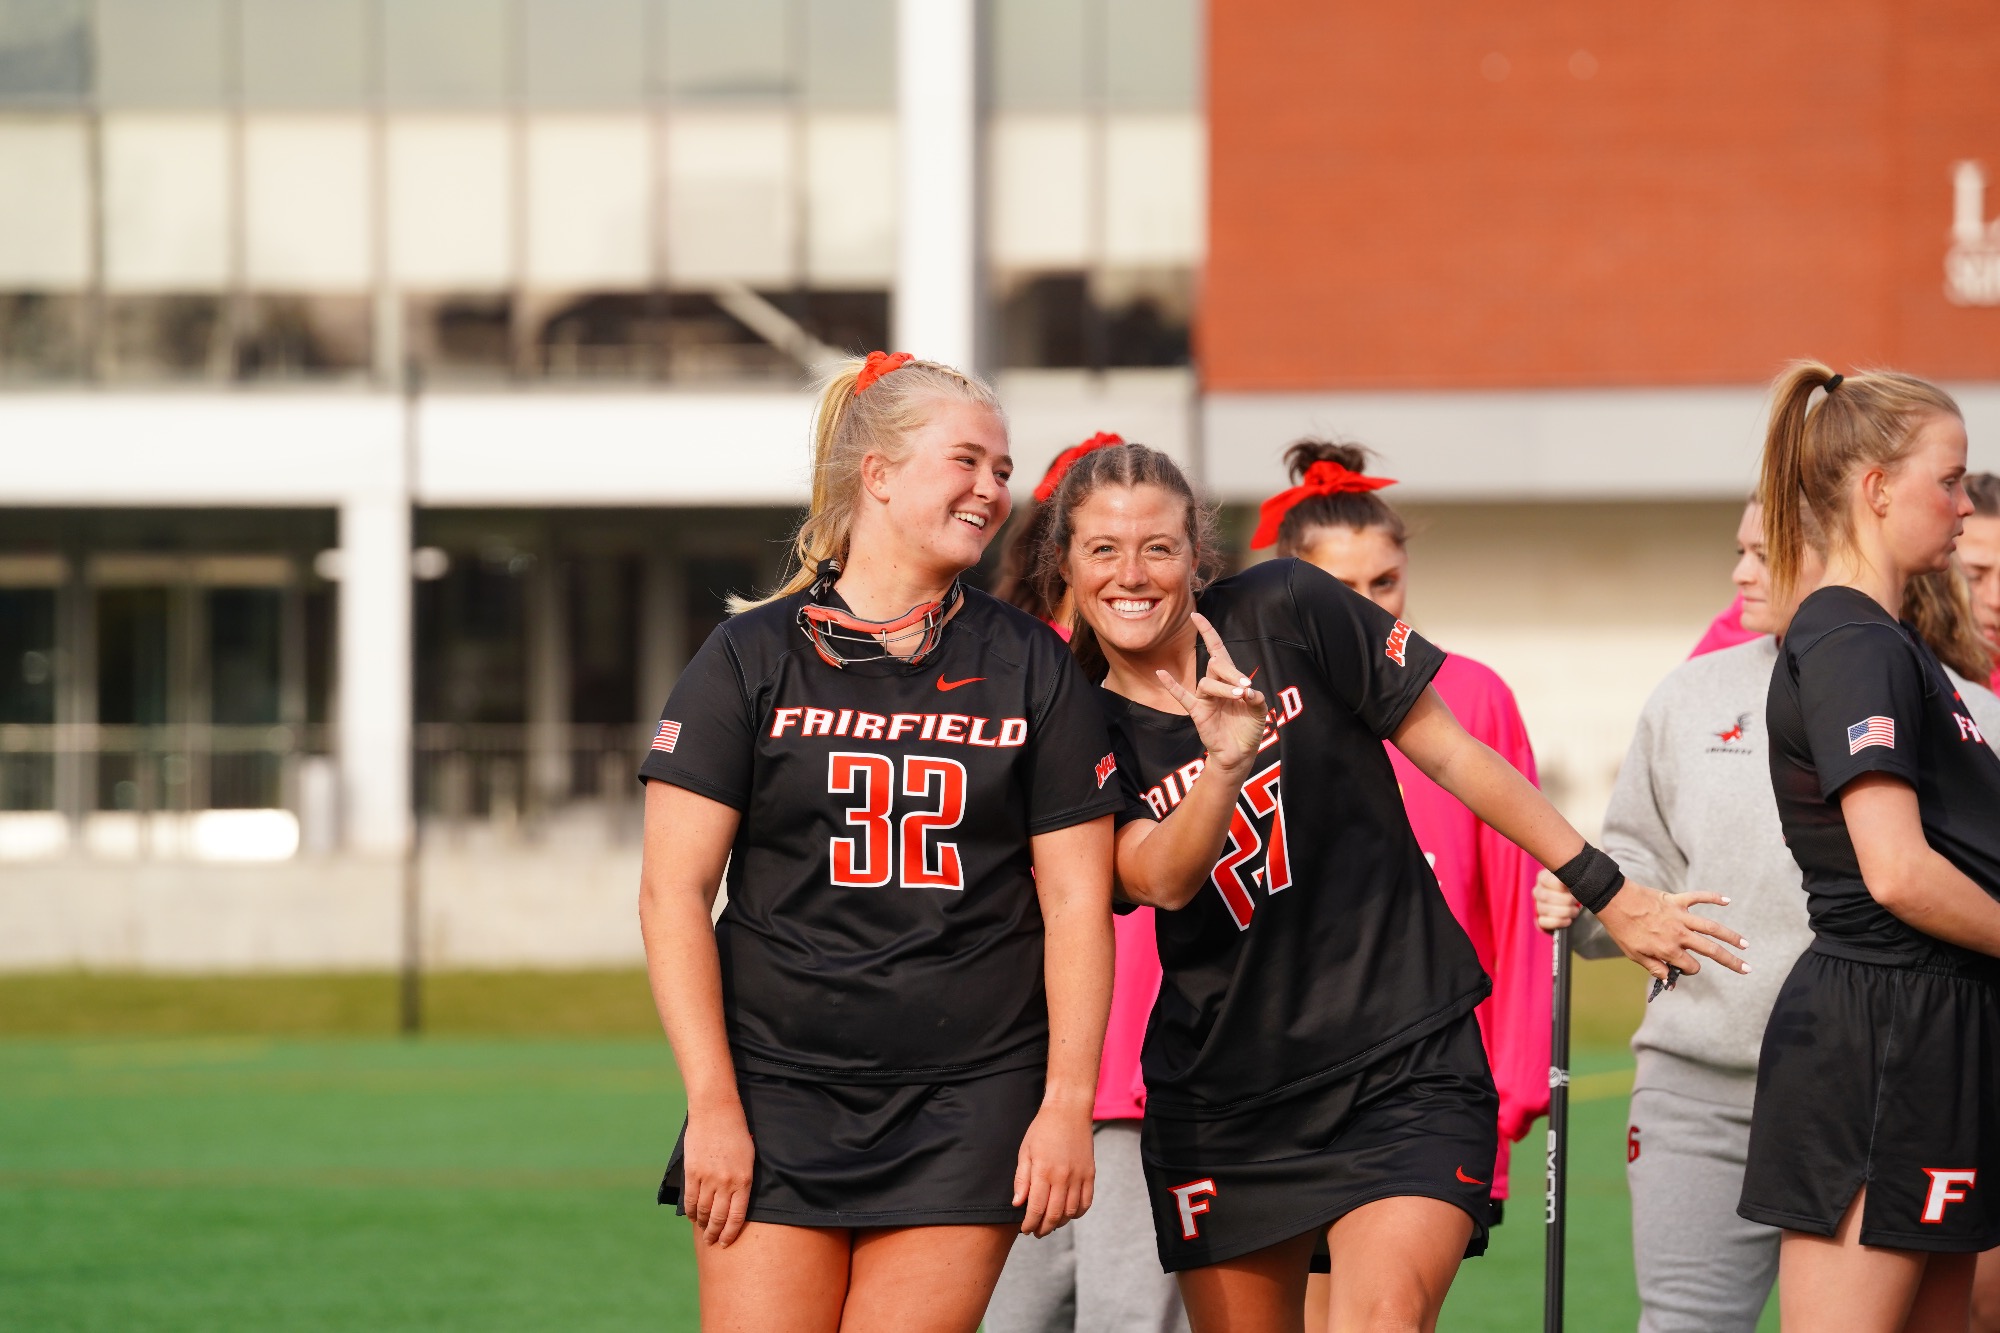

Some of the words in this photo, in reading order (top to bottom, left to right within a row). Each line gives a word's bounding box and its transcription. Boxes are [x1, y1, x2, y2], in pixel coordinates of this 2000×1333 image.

[770, 707, 1028, 747] FAIRFIELD
[827, 751, 967, 890] 32
[1210, 760, 1292, 931] 27
[1167, 1177, 1217, 1240] F
[1920, 1168, 1977, 1223] F
